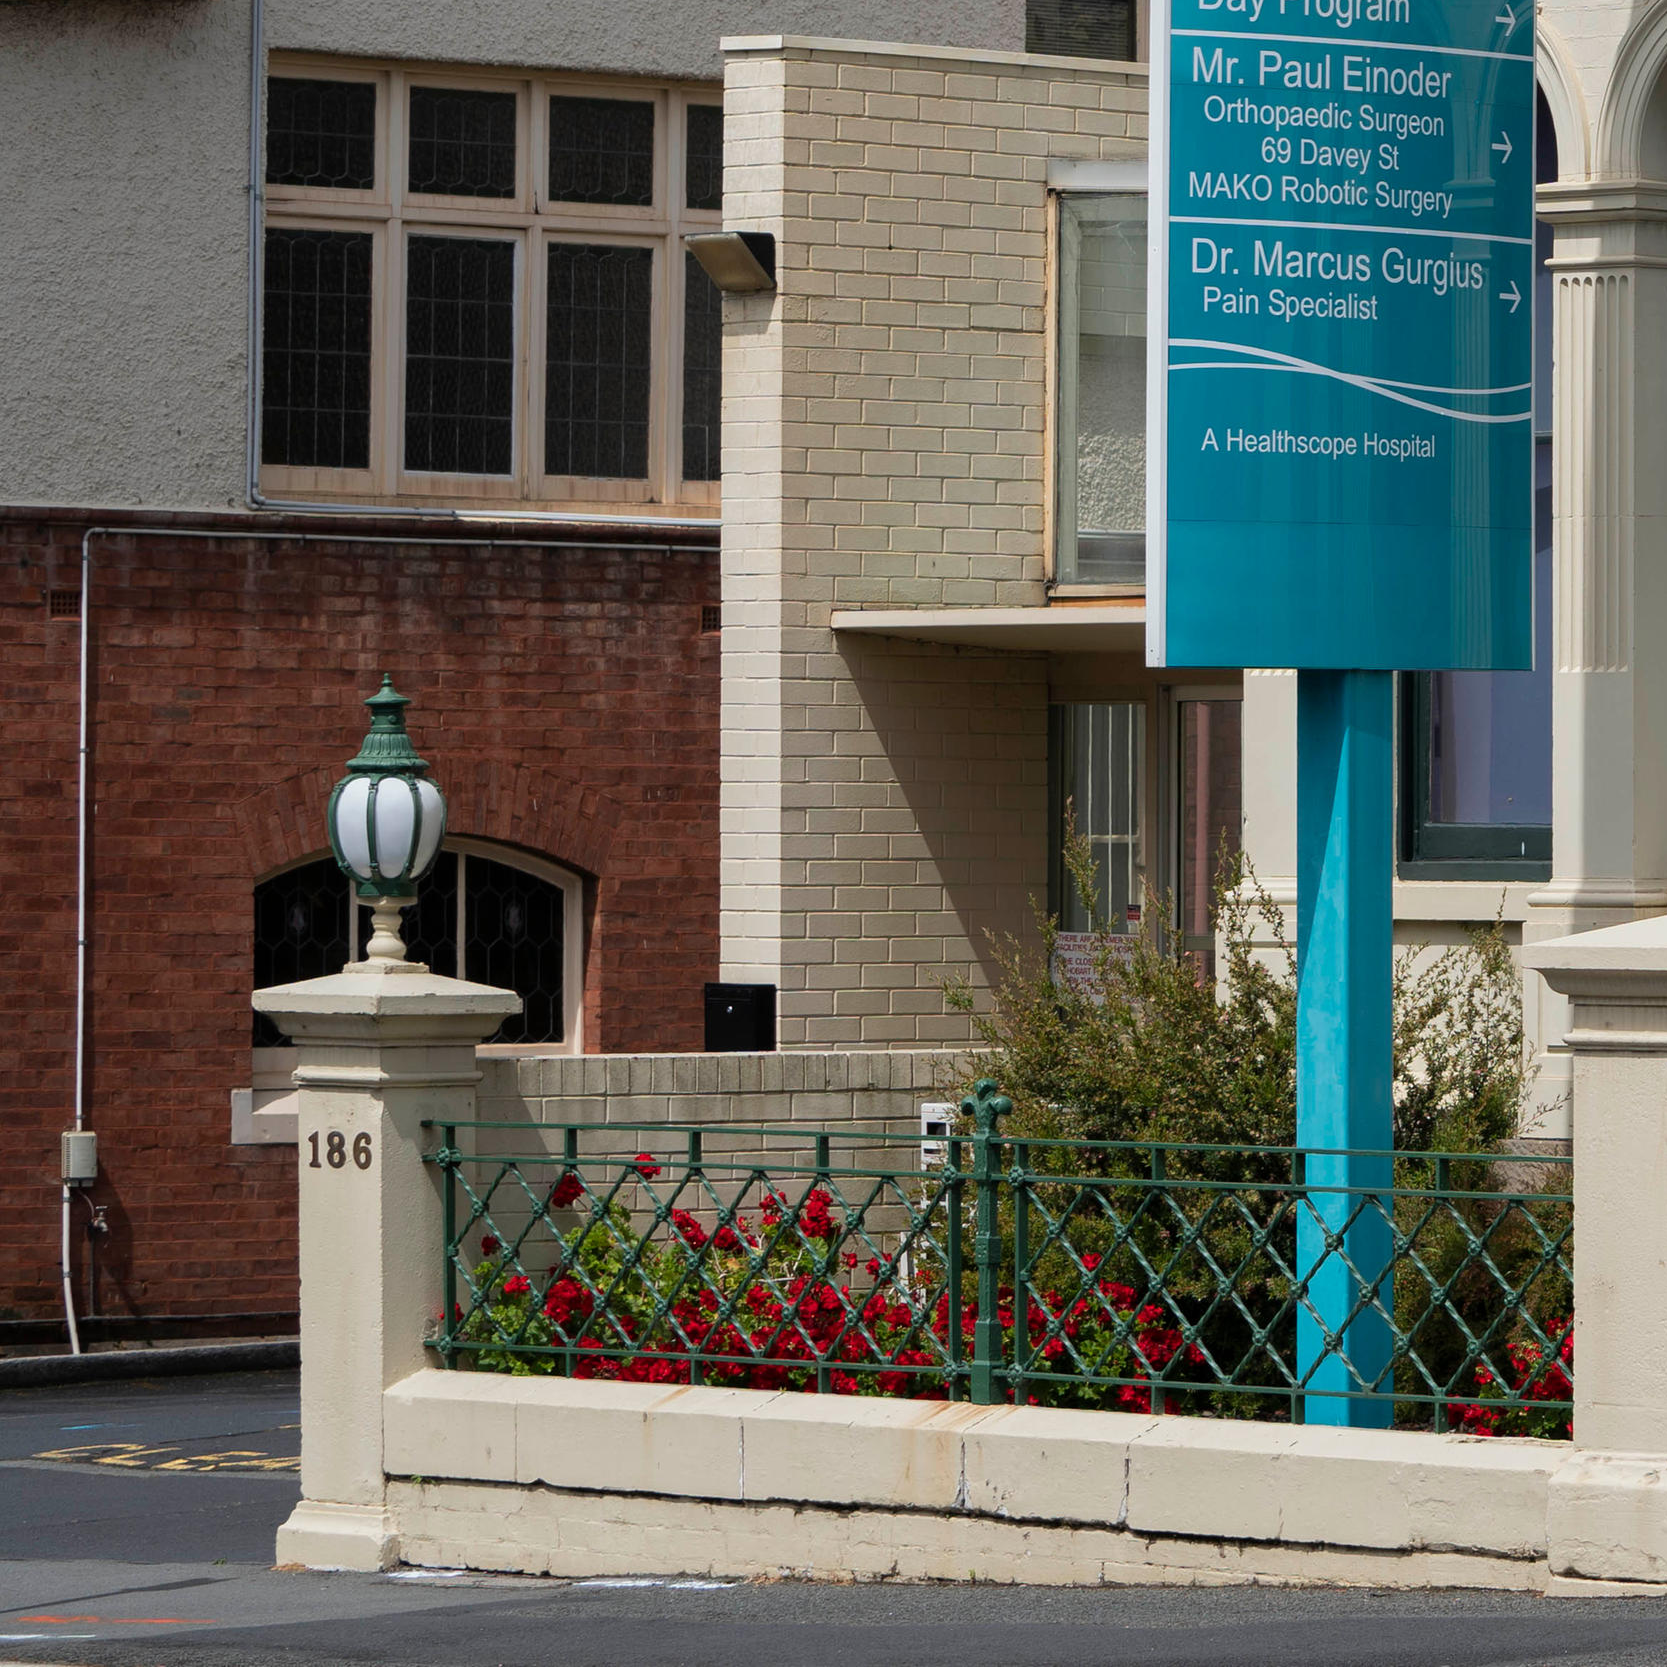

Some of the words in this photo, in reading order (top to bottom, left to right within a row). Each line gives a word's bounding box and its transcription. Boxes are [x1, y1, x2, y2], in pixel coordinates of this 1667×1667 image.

[1193, 46, 1243, 84] Mr.
[1260, 51, 1330, 89] Paul
[1344, 56, 1451, 97] Einoder
[1204, 95, 1352, 130] Orthopaedic
[1360, 106, 1443, 139] Surgeon
[1262, 137, 1291, 163] 69
[1301, 140, 1371, 173] Davey
[1379, 144, 1399, 170] St
[1190, 172, 1272, 201] MAKO
[1282, 176, 1368, 205] Robotic
[1376, 182, 1452, 218] Surgery
[1192, 238, 1238, 274] Dr.
[1255, 240, 1370, 281] Marcus
[1382, 248, 1482, 295] Gurgius
[1204, 286, 1258, 314] Pain
[1269, 290, 1378, 321] Specialist
[1201, 428, 1219, 451] A
[1227, 429, 1357, 459] Healthscope
[1364, 433, 1434, 462] Hospital
[308, 1131, 371, 1170] 186
